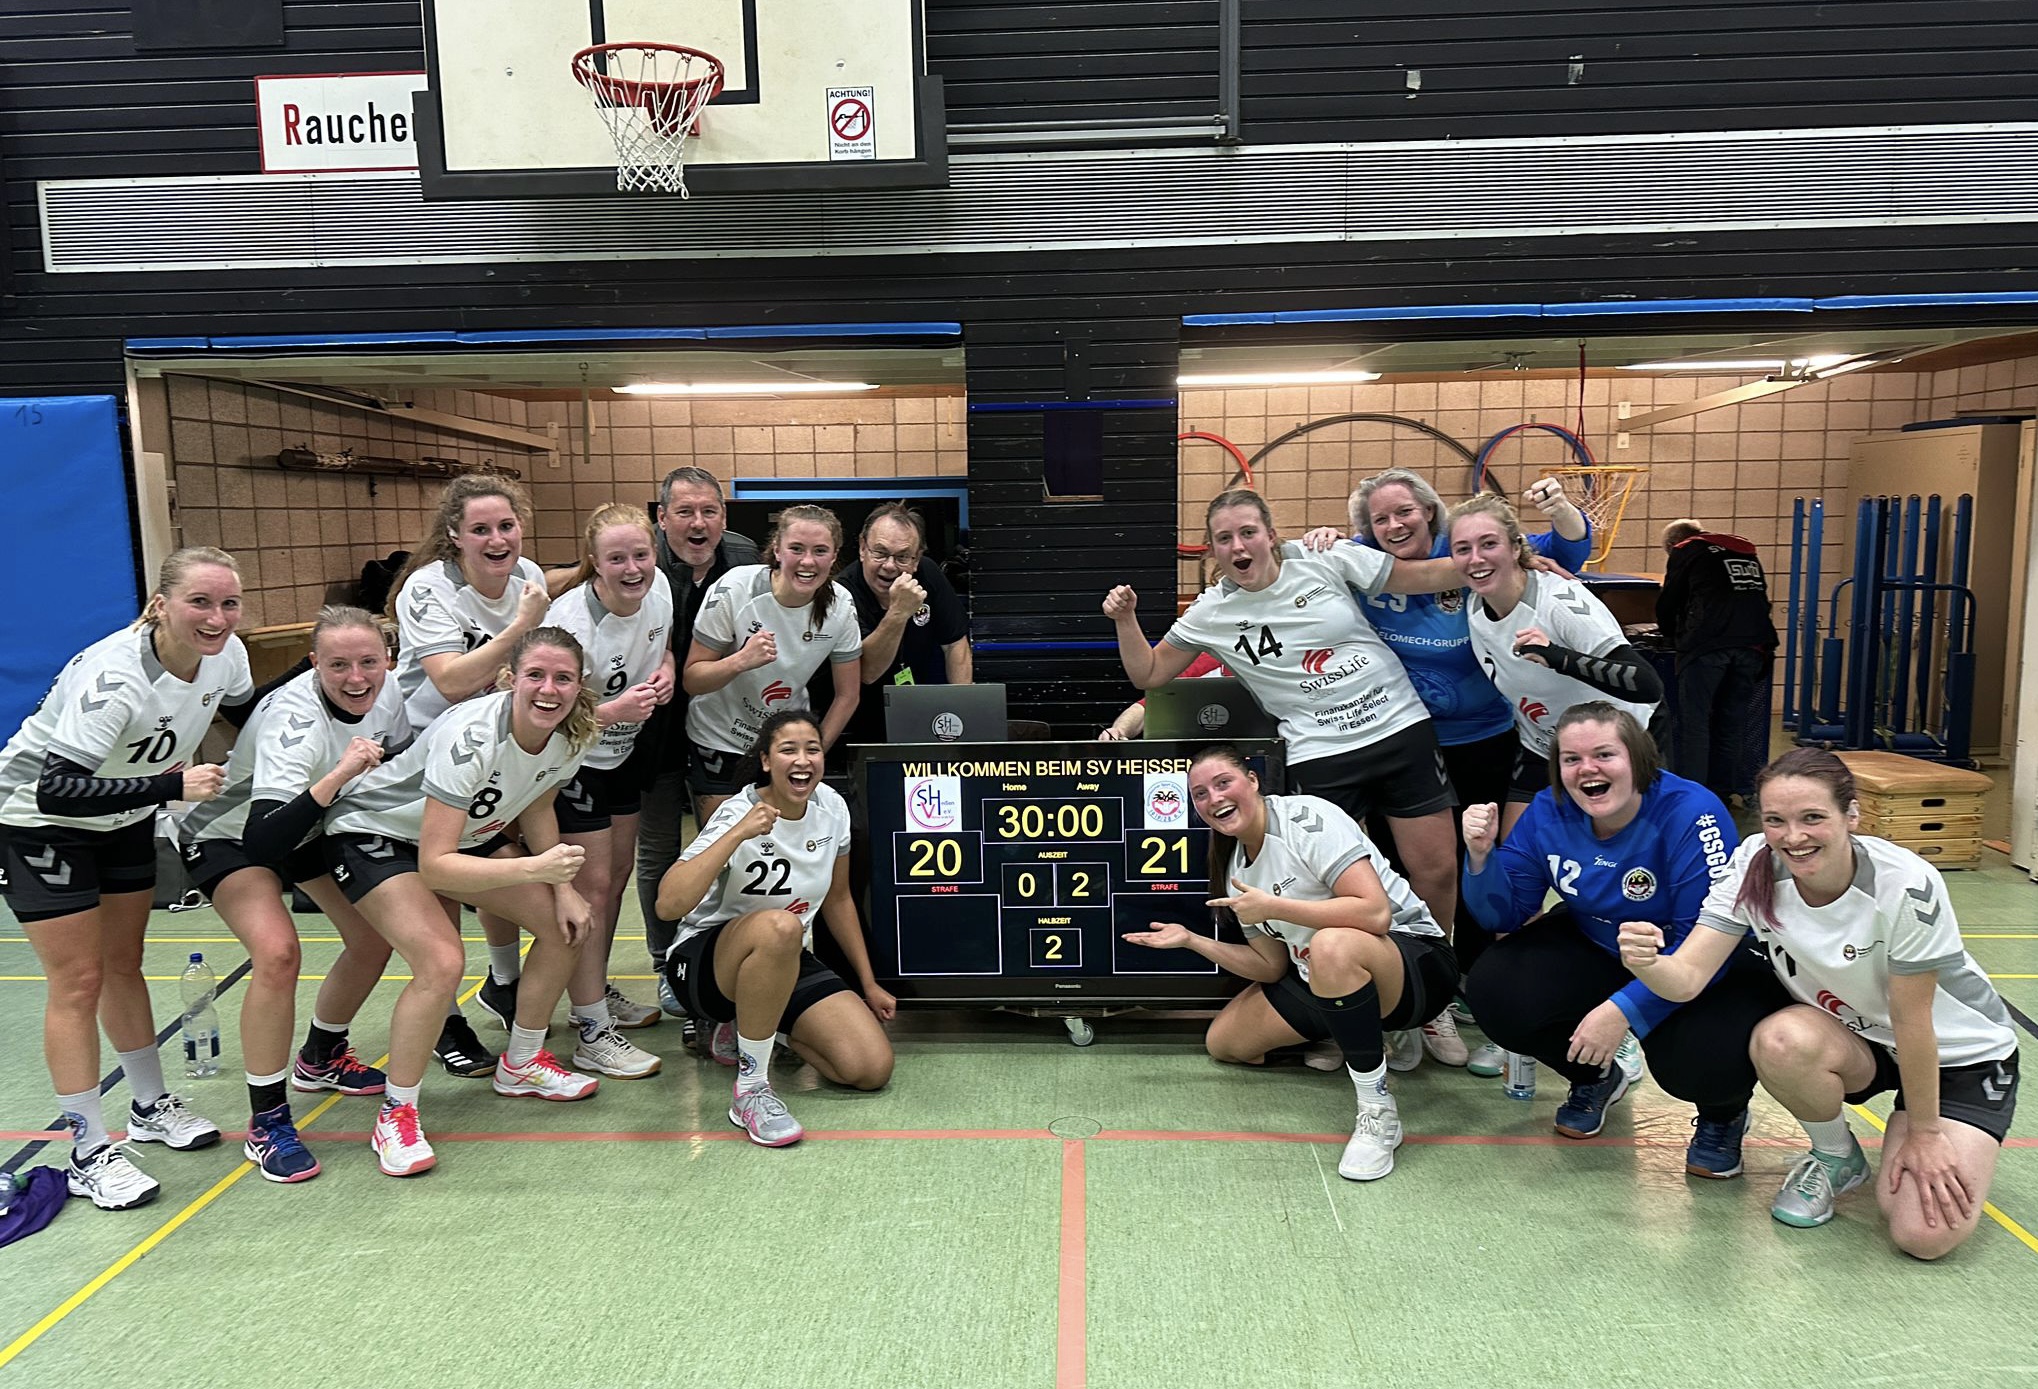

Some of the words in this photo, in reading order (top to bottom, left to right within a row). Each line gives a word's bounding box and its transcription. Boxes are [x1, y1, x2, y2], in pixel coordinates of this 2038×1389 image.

[830, 90, 870, 98] ACHTUNG!
[283, 101, 416, 146] Rauche
[15, 403, 43, 427] 15
[1234, 624, 1283, 666] 14
[603, 671, 627, 696] 9
[1314, 692, 1371, 717] Finanzkanzlei
[1317, 716, 1345, 727] Swiss
[1346, 709, 1362, 720] Life
[1362, 694, 1389, 712] Select
[730, 727, 755, 743] Swiss
[1339, 723, 1348, 732] in
[1350, 713, 1377, 729] Essen
[126, 729, 177, 764] 10
[902, 761, 1031, 778] WILLKOMMEN
[1035, 760, 1081, 776] BEIM
[1086, 759, 1112, 776] SV
[1002, 783, 1027, 792] Home
[1076, 782, 1100, 792] Away
[468, 786, 503, 819] 8
[998, 804, 1104, 838] 30:00
[909, 839, 962, 877] 20
[1038, 851, 1069, 859] AUSZEIT
[1140, 836, 1188, 874] 21
[740, 858, 792, 896] 22
[1018, 872, 1036, 898] 0
[1071, 871, 1090, 897] 2
[1151, 883, 1179, 891] STRAFE
[1547, 854, 1582, 897] 12
[1045, 935, 1063, 960] 2
